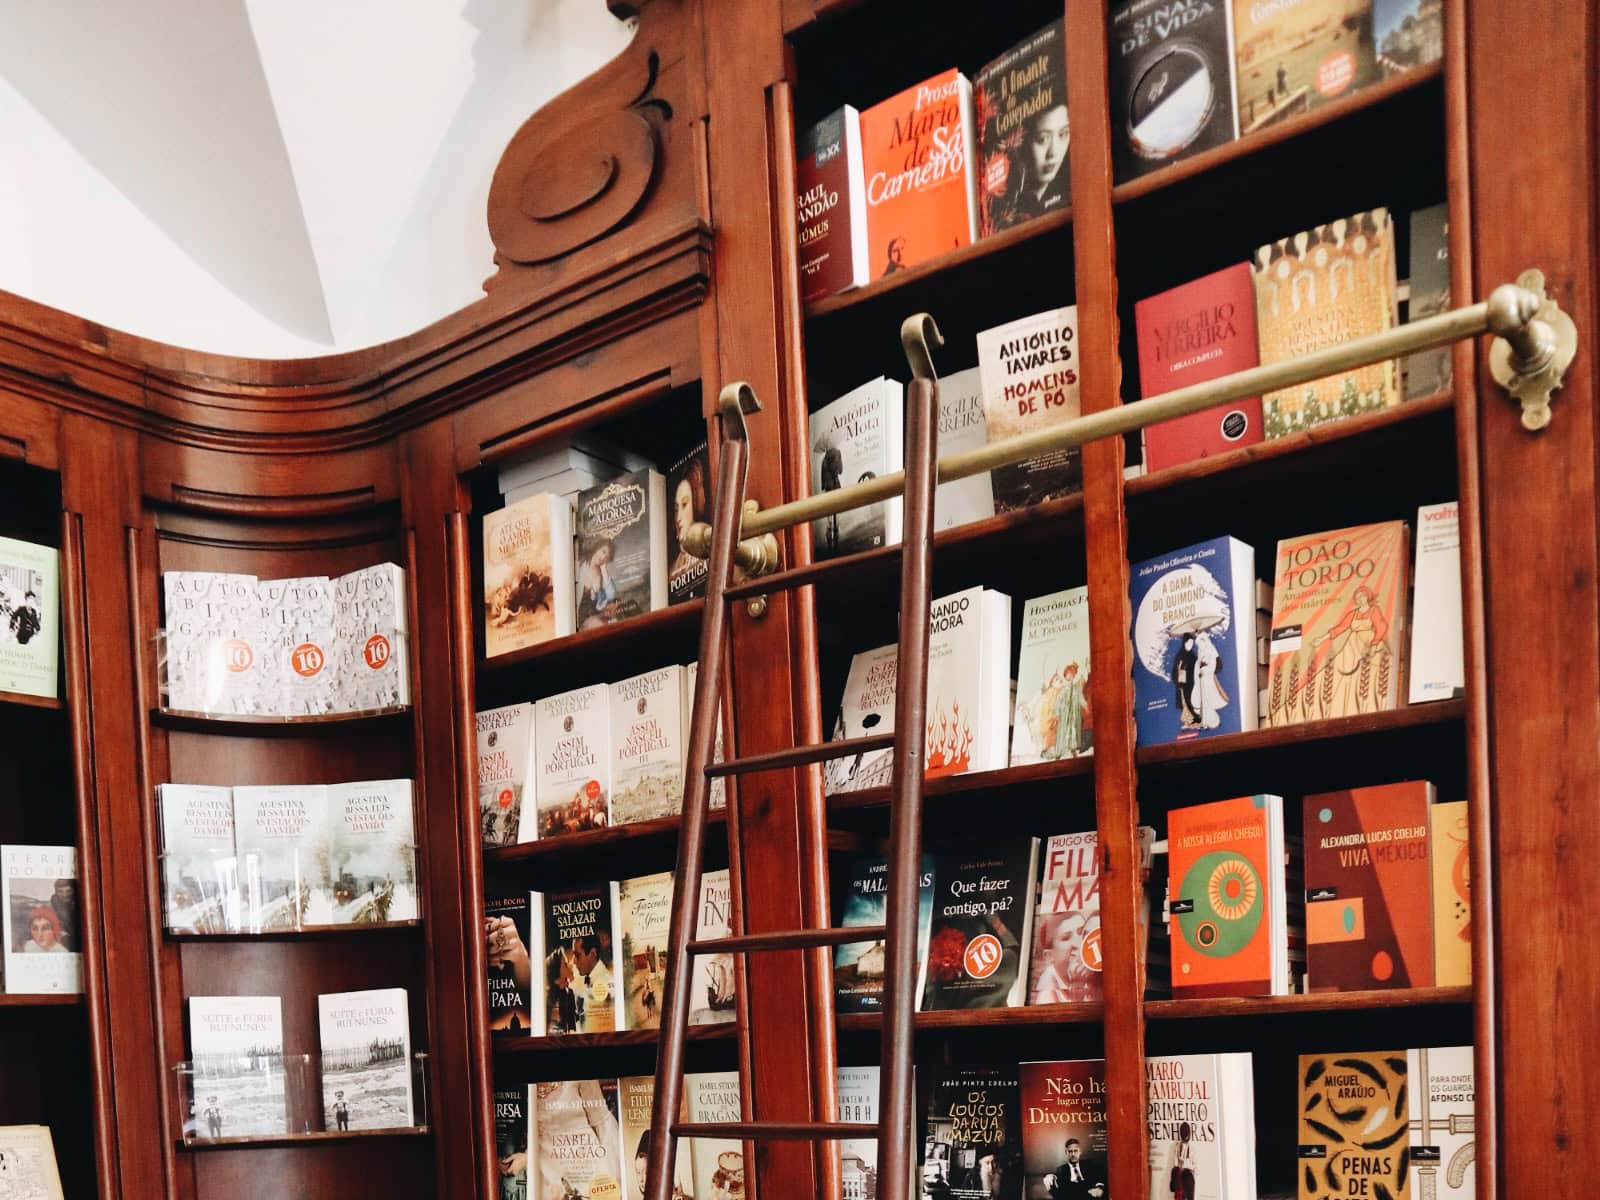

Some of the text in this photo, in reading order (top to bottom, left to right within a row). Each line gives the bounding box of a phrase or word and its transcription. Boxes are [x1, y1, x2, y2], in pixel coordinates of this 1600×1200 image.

[1154, 3, 1214, 39] VIDA
[915, 79, 960, 111] Prosa
[889, 103, 959, 150] Mário
[932, 124, 962, 153] Sá
[868, 150, 962, 206] Carneiro
[1000, 326, 1073, 360] ANTÓNIO
[1006, 346, 1072, 375] TAVARES
[1004, 370, 1076, 400] HOMENS
[1018, 388, 1065, 416] DE PÓ
[830, 397, 880, 433] António
[846, 416, 880, 441] Mota
[588, 491, 637, 518] MARQUESA
[594, 505, 633, 525] ALORNA
[1285, 537, 1351, 570] JOÃO
[670, 560, 709, 593] PORTUGA
[1283, 557, 1375, 590] TORDO
[1162, 575, 1194, 594] A DAMA
[1153, 586, 1205, 613] DO QUIMONO
[1162, 606, 1196, 625] BRANCO
[296, 650, 321, 671] 10
[367, 643, 389, 664] 10
[617, 671, 670, 695] DOMINGOS
[623, 682, 664, 702] AMARAL
[543, 689, 596, 712] DOMINGOS
[550, 700, 588, 717] AMARAL
[476, 709, 521, 726] OMINGOS
[630, 719, 657, 735] ASSIM
[556, 736, 585, 752] ASSIM
[625, 727, 662, 746] NASCEU
[551, 744, 590, 763] NASCEU
[619, 736, 671, 761] PORTUGAL
[545, 753, 598, 774] PORTUGAL
[1052, 835, 1081, 848] HUGO
[1320, 826, 1426, 849] ALEXANDRA LUCAS COELHO
[1339, 850, 1370, 868] VIVA
[950, 877, 1010, 896] Que fazer
[552, 898, 601, 916] ENQUANTO
[943, 896, 1013, 918] contigo, pá?
[557, 912, 596, 928] SALAZAR
[559, 926, 595, 940] DORMIA
[972, 940, 997, 970] 10
[487, 978, 515, 991] FILHA
[492, 991, 523, 1007] PAPA
[1145, 1059, 1184, 1081] MÁRIO
[1046, 1077, 1083, 1096] Não
[1324, 1075, 1360, 1087] MIGUEL
[968, 1091, 987, 1103] OS
[1057, 1097, 1101, 1107] lugar para
[1338, 1087, 1375, 1098] ARAÚJO
[1431, 1094, 1464, 1102] AFONSO
[949, 1103, 1004, 1117] LOUCOS
[1146, 1101, 1208, 1122] PRIMEIRO
[953, 1117, 999, 1129] DA RUA
[1149, 1122, 1215, 1143] SENHORAS
[552, 1133, 593, 1146] ISABEL
[950, 1129, 1004, 1143] MAZUR
[551, 1145, 606, 1159] ARAGÃO
[1342, 1157, 1392, 1175] PENAS
[1349, 1178, 1368, 1195] DE
